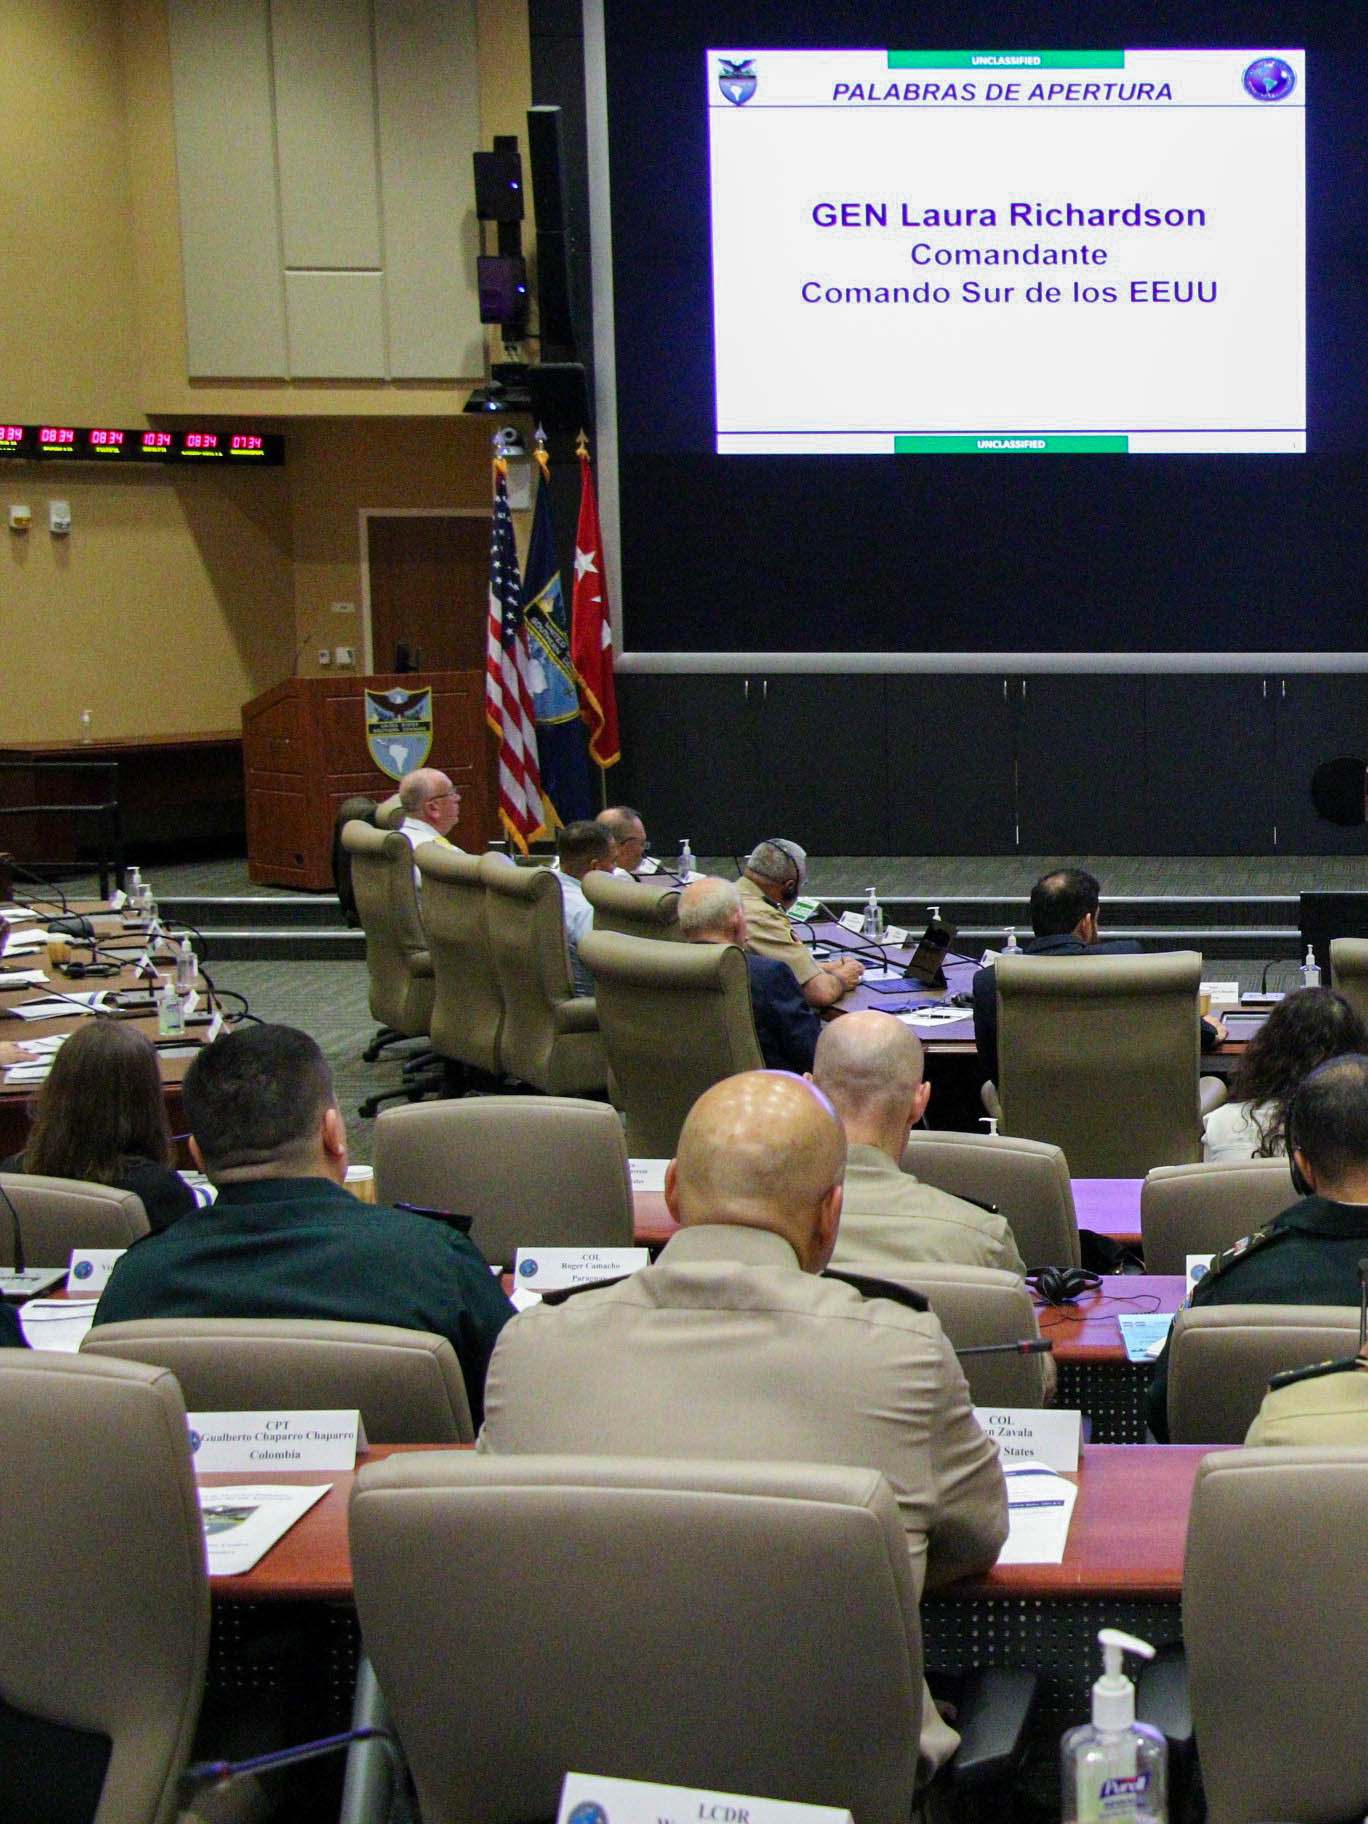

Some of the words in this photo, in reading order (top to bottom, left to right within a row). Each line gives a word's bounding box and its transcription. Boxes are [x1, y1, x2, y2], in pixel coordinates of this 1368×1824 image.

[971, 55, 1041, 66] UNCLASSIFIED
[832, 83, 976, 101] PALABRAS
[985, 83, 1021, 101] DE
[1028, 83, 1173, 101] APERTURA
[812, 203, 887, 227] GEN
[901, 203, 997, 227] Laura
[1010, 202, 1206, 227] Richardson
[911, 243, 1108, 266] Comandante
[801, 281, 950, 304] Comando
[962, 281, 1015, 304] Sur
[1025, 281, 1061, 303] de
[1073, 281, 1118, 303] los
[1130, 281, 1218, 303] EEUU
[977, 439, 1046, 450] UNCLASSIFIED
[265, 1420, 292, 1431] CPT
[988, 1415, 1015, 1426] COL
[254, 1431, 303, 1443] Chaparro
[305, 1430, 355, 1441] Chaparro
[997, 1426, 1034, 1438] Zavala
[249, 1449, 302, 1461] Colombia
[1003, 1446, 1035, 1457] States
[699, 1802, 751, 1824] LCDR
